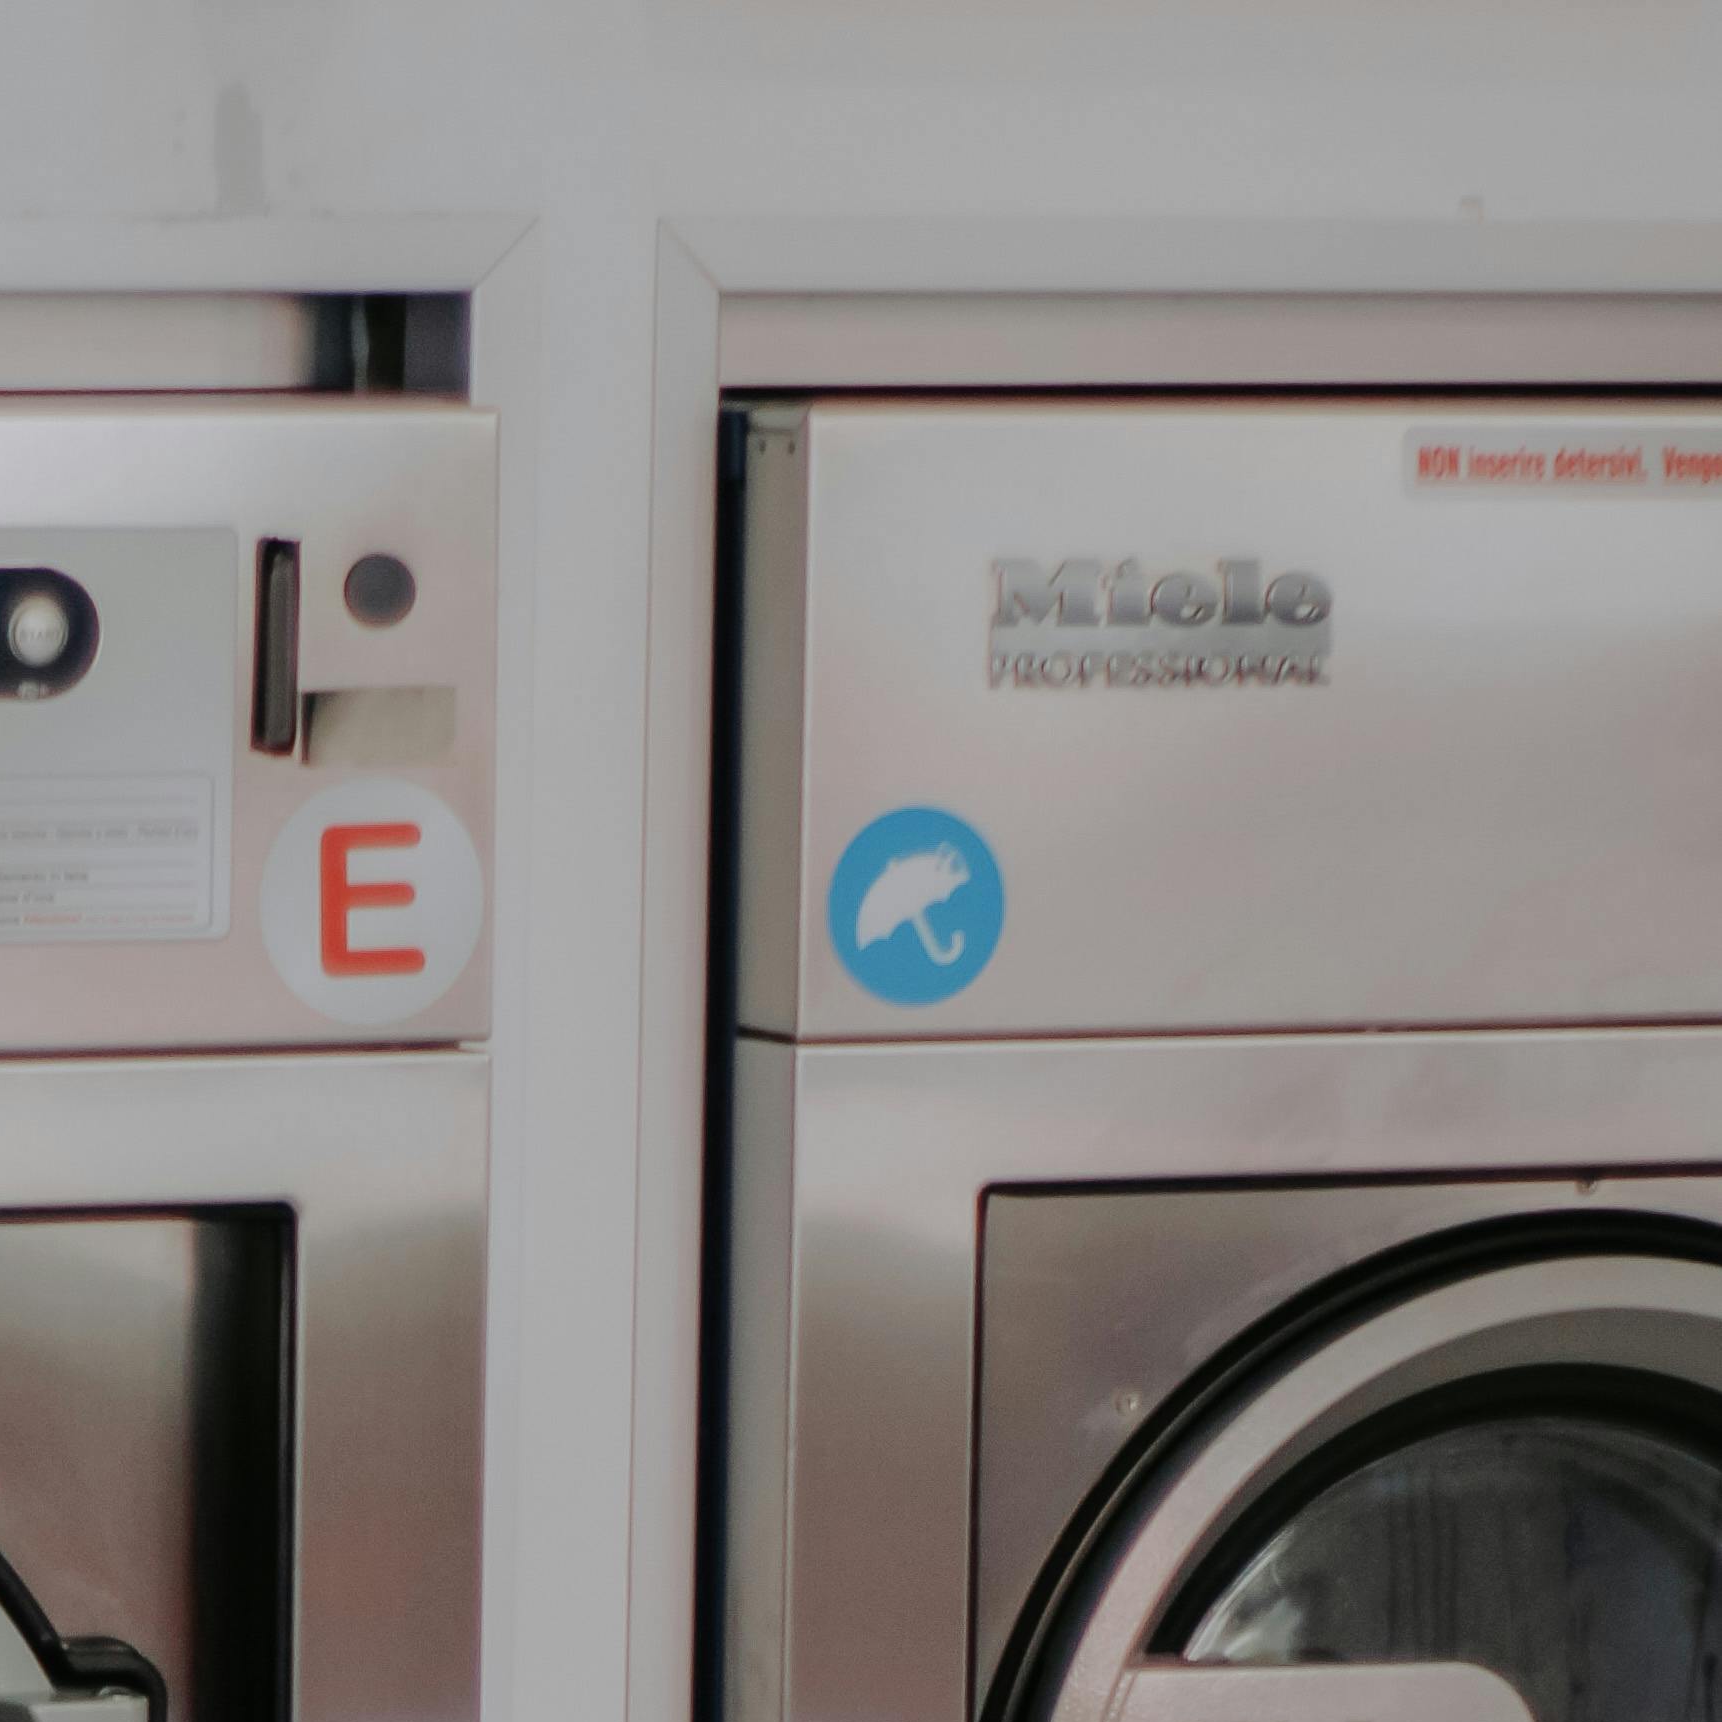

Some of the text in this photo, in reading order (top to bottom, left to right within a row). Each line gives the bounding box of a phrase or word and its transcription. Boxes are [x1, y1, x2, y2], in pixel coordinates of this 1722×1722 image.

[1417, 445, 1460, 479] NON
[1468, 443, 1546, 480] inserire
[990, 556, 1334, 629] Miele
[989, 650, 1331, 690] PROFESSIONAL
[320, 821, 425, 976] E
